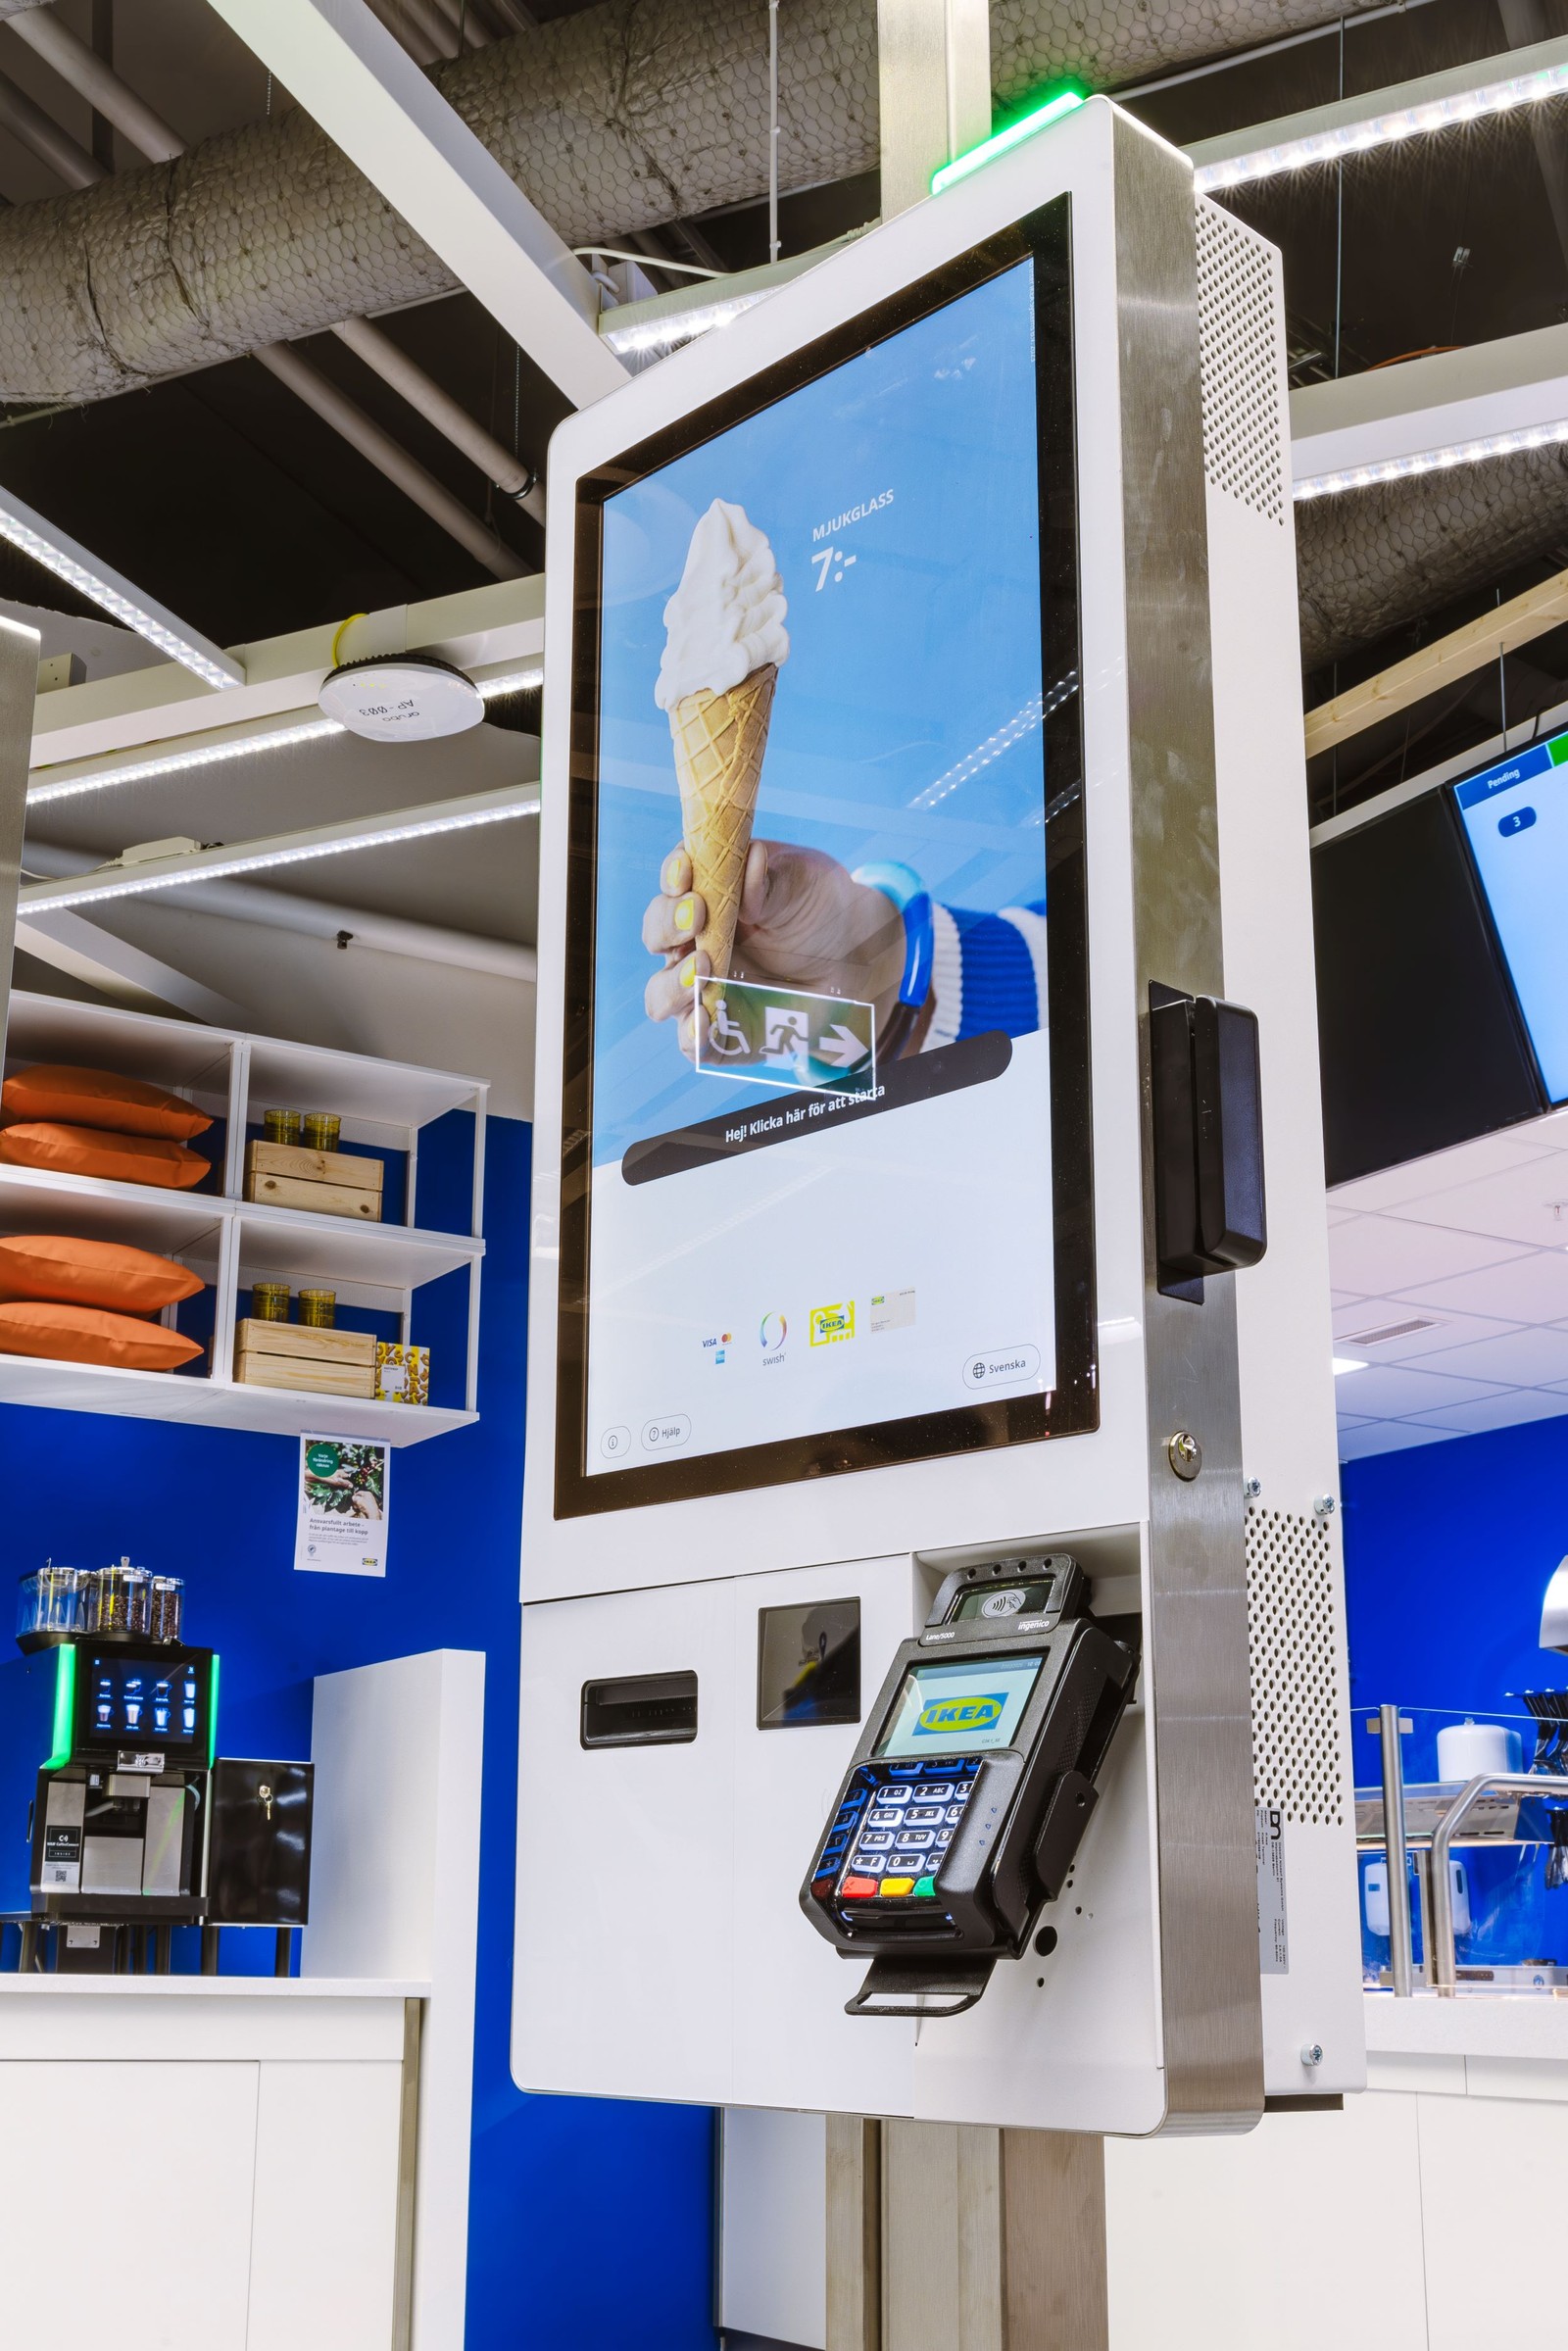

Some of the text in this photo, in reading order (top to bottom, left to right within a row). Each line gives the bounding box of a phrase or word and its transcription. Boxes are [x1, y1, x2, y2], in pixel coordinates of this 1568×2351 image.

[812, 489, 895, 542] MJUKGLASS
[811, 546, 857, 593] 7:-
[382, 711, 419, 722] aruba
[1487, 768, 1521, 789] Pending
[1512, 815, 1521, 827] 3
[725, 1125, 748, 1144] Hej!
[750, 1116, 783, 1136] Klicka
[786, 1107, 806, 1125] här
[808, 1102, 826, 1118] för
[828, 1095, 847, 1110] att
[702, 1338, 717, 1347] VISA
[762, 1352, 784, 1366] swish
[989, 1359, 1026, 1374] Svenska
[662, 1427, 680, 1439] Hjälp
[1018, 1620, 1050, 1631] ingenico
[924, 1703, 995, 1725] IKEA
[883, 1788, 889, 1797] 1
[920, 1787, 928, 1796] 2
[959, 1784, 968, 1793] 3
[872, 1811, 880, 1820] 4
[910, 1809, 919, 1819] 5
[950, 1807, 957, 1816] 6
[864, 1834, 872, 1843] 7
[902, 1833, 909, 1842] 8
[941, 1831, 949, 1840] 9
[870, 1857, 877, 1866] F
